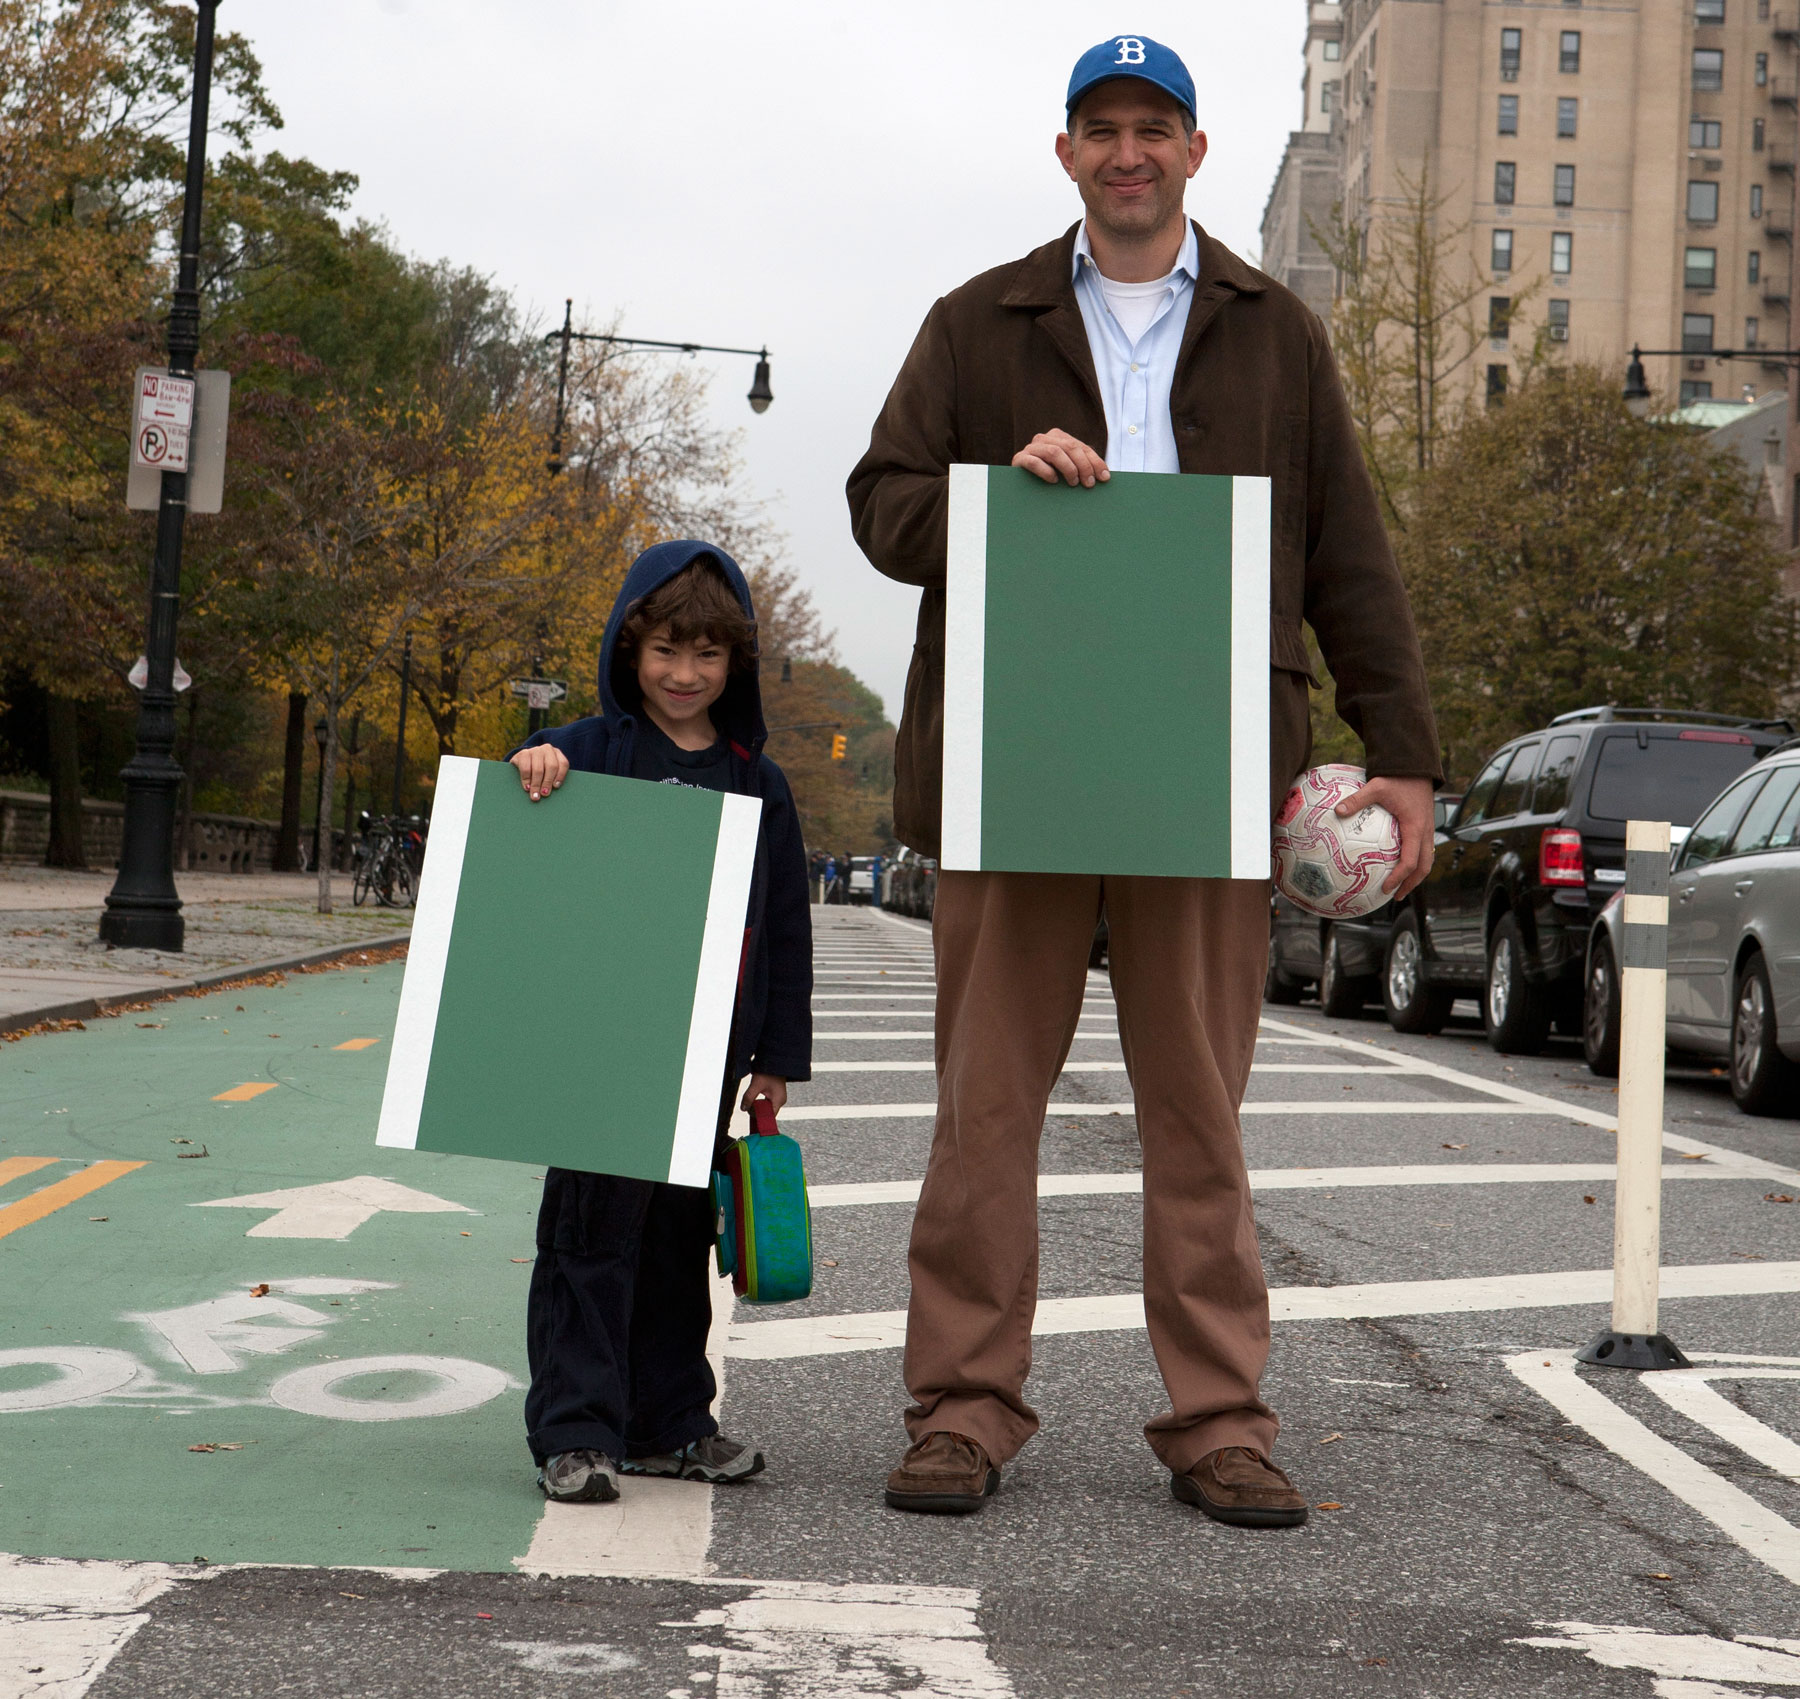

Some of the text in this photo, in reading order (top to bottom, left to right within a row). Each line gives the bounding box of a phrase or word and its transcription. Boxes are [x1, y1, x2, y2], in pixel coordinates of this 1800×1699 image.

[1114, 38, 1147, 65] B
[143, 377, 190, 395] NO PARKING
